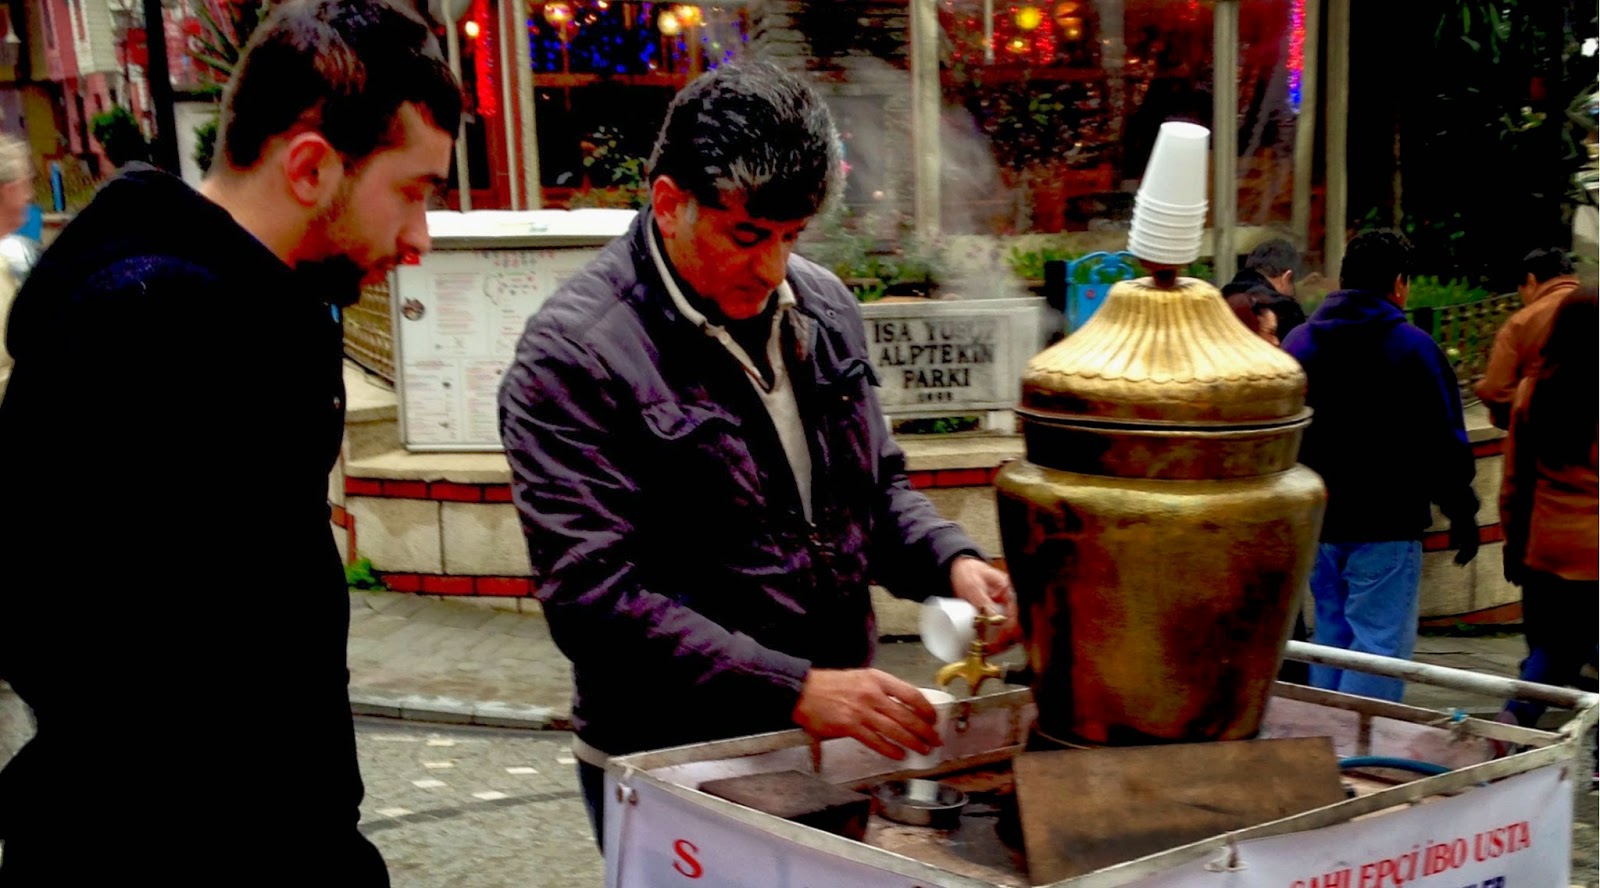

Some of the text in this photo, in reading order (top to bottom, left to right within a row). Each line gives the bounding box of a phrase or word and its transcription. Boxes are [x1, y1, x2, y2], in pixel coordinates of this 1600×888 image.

[922, 320, 995, 342] YUS
[902, 367, 971, 389] PARKI
[1473, 821, 1531, 862] USTA
[672, 838, 704, 879] S
